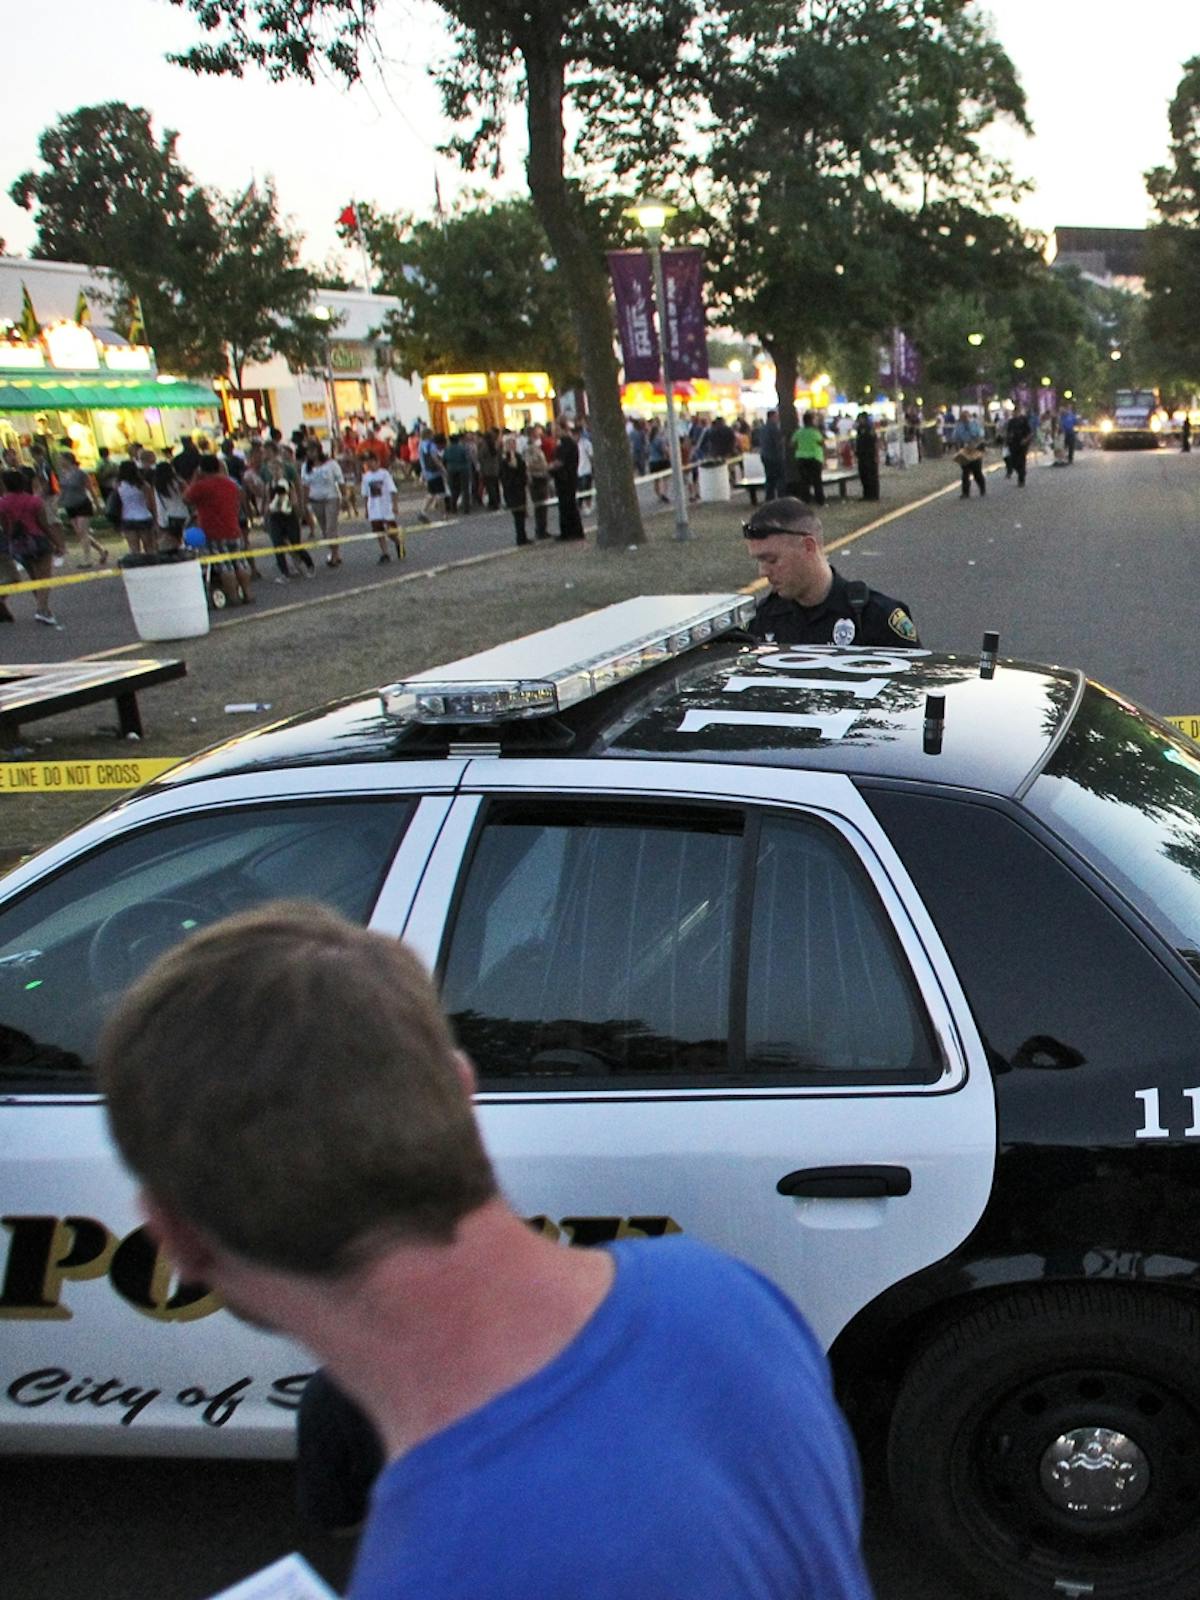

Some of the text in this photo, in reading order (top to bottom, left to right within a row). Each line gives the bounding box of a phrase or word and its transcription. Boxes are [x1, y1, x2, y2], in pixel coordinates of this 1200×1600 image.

[9, 766, 38, 788] LINE
[44, 765, 61, 786] DO
[66, 764, 91, 785] NOT
[96, 763, 140, 783] CROSS
[7, 1367, 161, 1426] City
[176, 1376, 253, 1428] of
